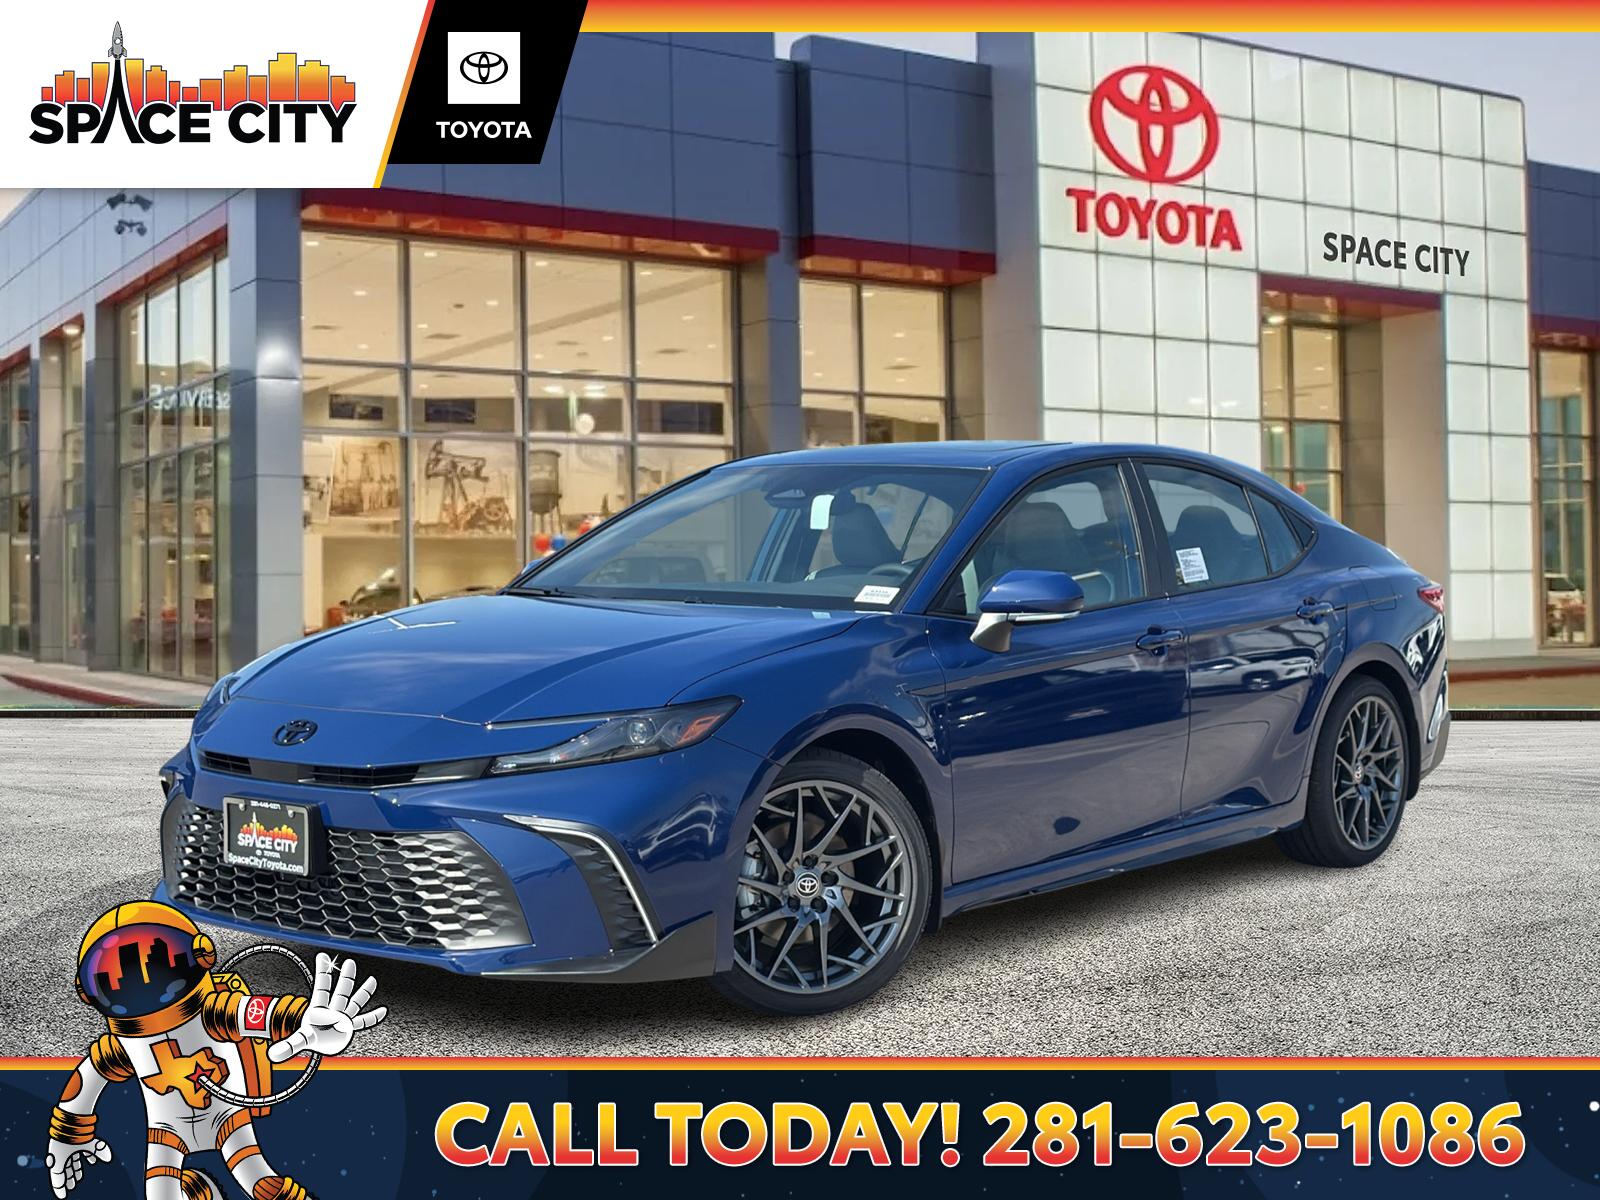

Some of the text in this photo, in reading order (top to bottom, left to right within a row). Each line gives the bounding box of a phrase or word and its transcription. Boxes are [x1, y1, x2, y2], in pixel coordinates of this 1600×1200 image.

[1066, 187, 1242, 251] TOYOTA
[1323, 232, 1470, 277] SPACE CITY
[237, 832, 298, 853] SPACE CITY
[228, 852, 304, 873] SpaceCityToyota.com
